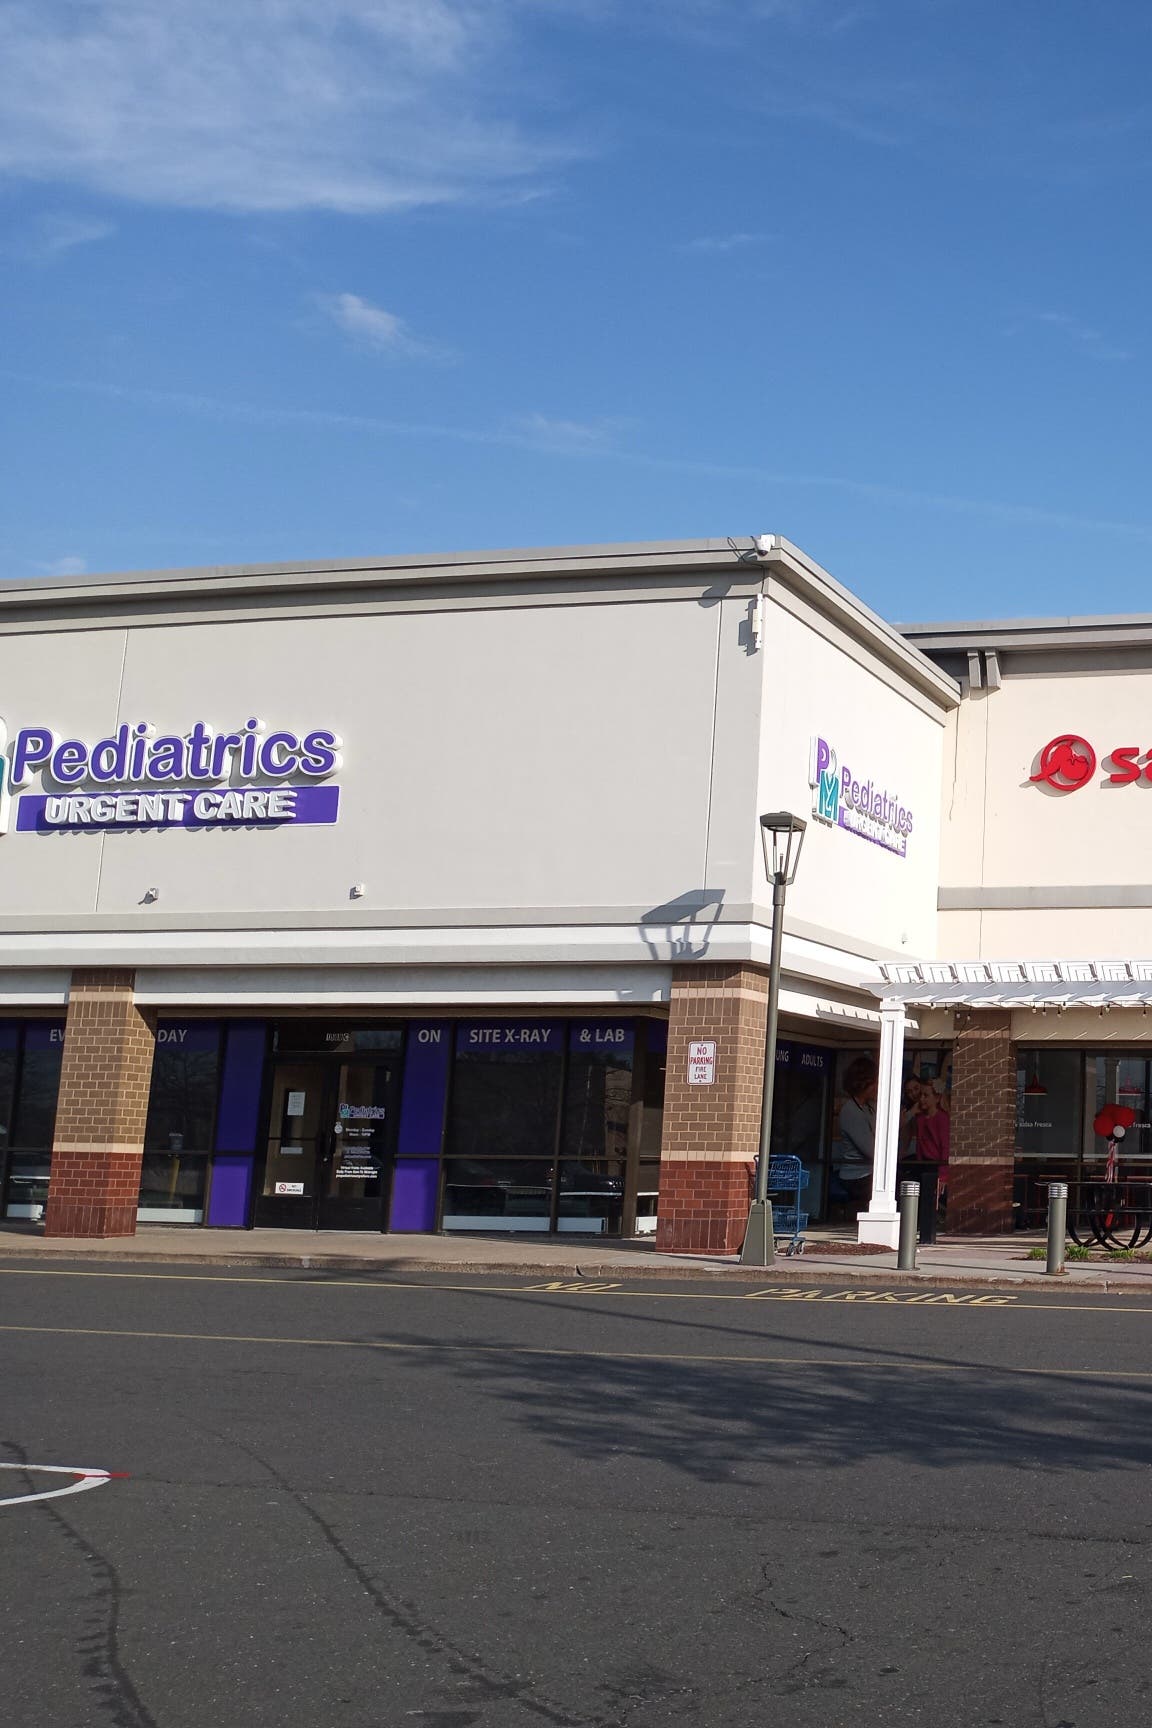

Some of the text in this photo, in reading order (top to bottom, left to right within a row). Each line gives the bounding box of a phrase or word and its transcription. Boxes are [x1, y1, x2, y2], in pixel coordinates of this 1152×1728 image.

[11, 717, 342, 785] Pediatrics
[45, 790, 297, 824] URGENT CARE
[840, 766, 913, 833] Pediatrics
[157, 1029, 188, 1043] DAY
[418, 1028, 625, 1043] ON SITE X-RAY & LAB
[697, 1046, 708, 1056] NO
[776, 1050, 824, 1067] UNG ADULTS
[690, 1056, 713, 1065] PARKING
[523, 1281, 622, 1291] NO
[744, 1288, 1019, 1304] PARKING
